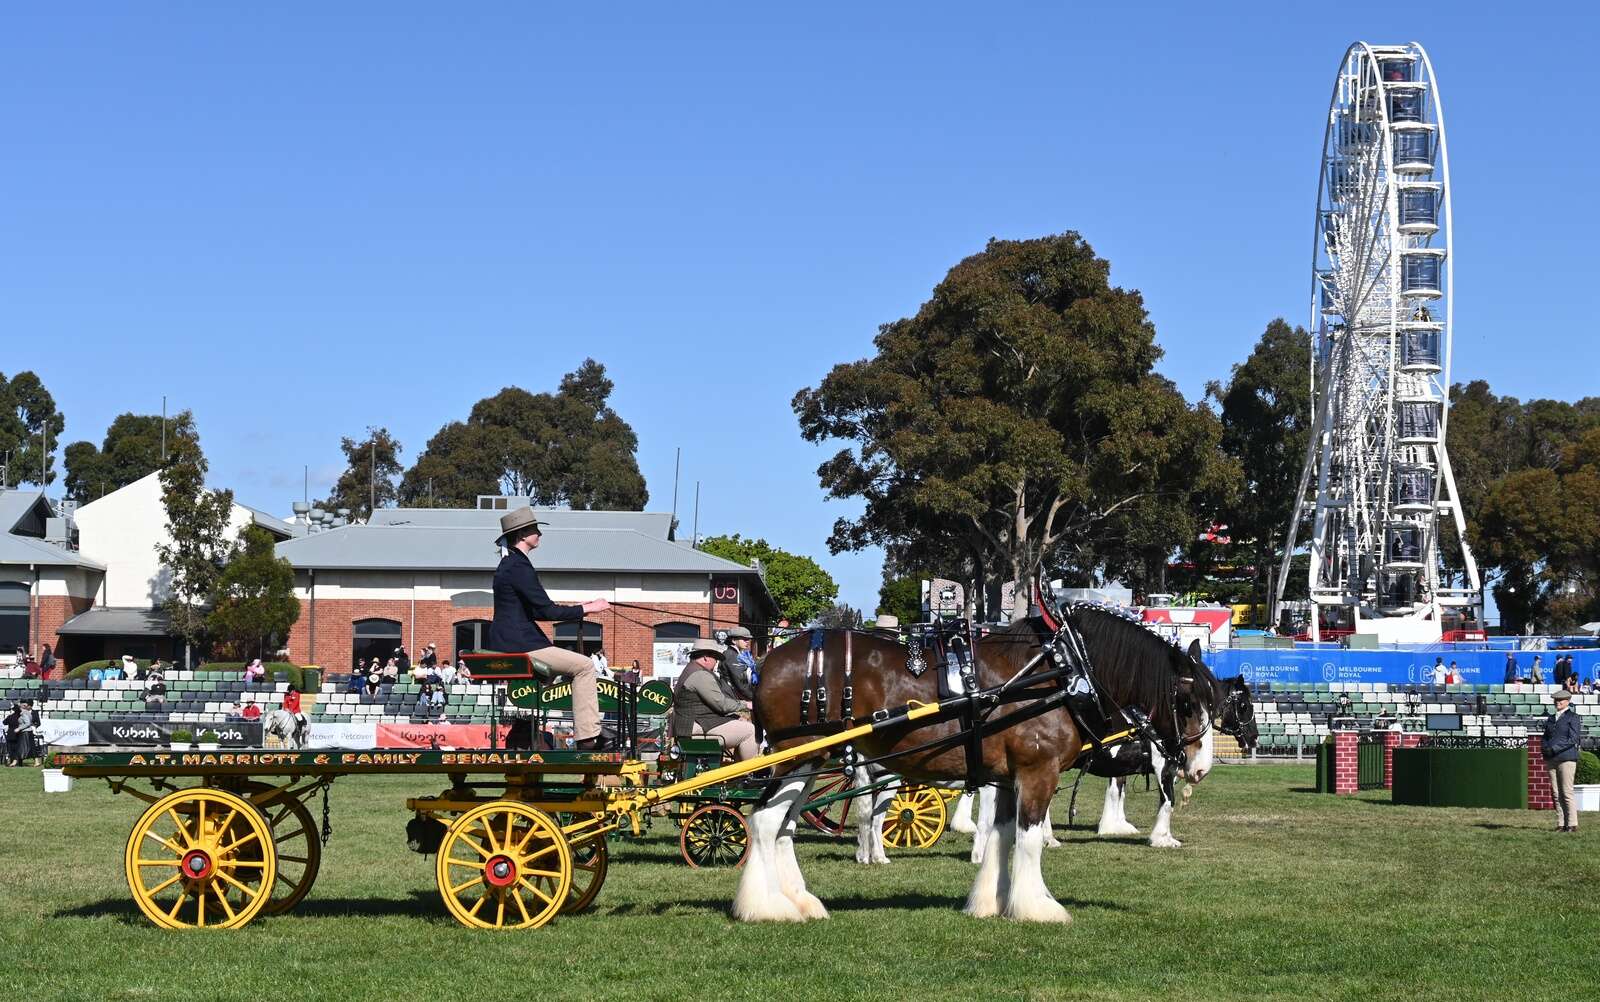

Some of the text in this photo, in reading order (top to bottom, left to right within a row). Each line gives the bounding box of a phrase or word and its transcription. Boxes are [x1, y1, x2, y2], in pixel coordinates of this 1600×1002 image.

[642, 688, 669, 706] COKE
[112, 726, 160, 739] Kubota
[196, 728, 243, 740] Kbota
[401, 730, 446, 743] Kubota
[182, 753, 300, 766] MARRIOTT
[313, 754, 330, 765] &
[341, 753, 423, 765] FAMILY
[441, 753, 545, 765] BENALLA
